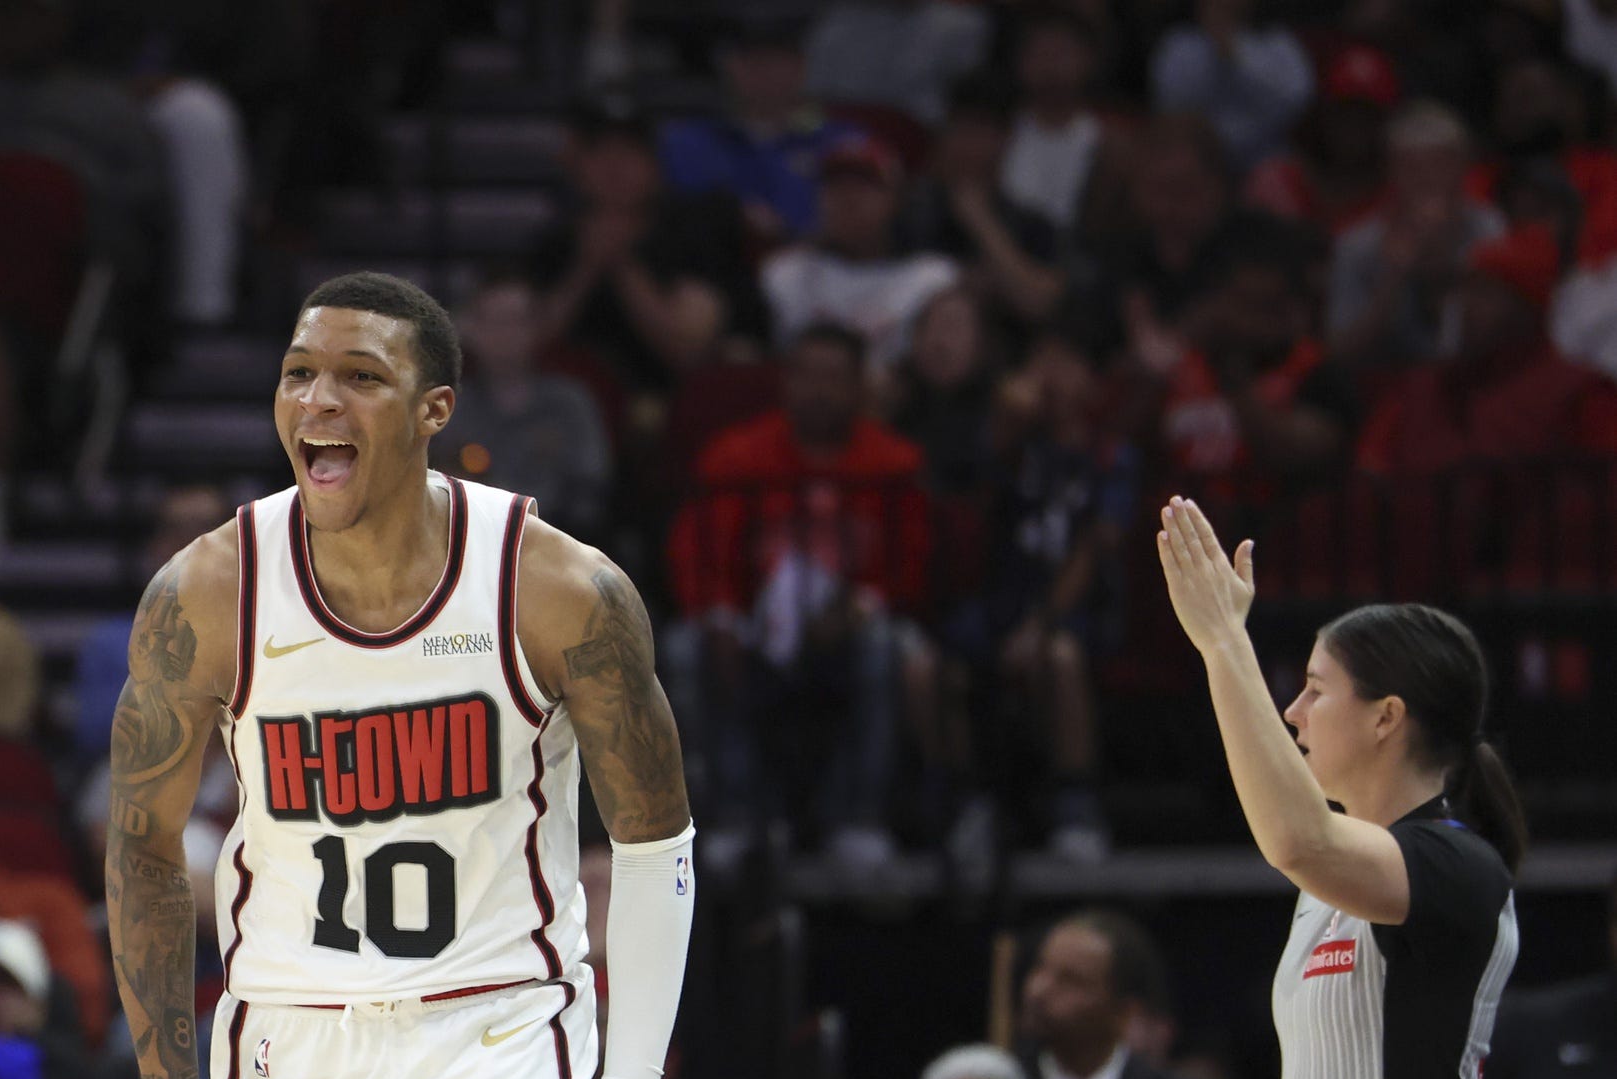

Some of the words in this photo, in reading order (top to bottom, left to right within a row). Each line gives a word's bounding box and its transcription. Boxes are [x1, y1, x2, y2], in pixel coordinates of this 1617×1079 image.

[423, 632, 493, 648] MEMORIAL
[423, 641, 493, 657] HERMANN
[312, 834, 458, 960] 10
